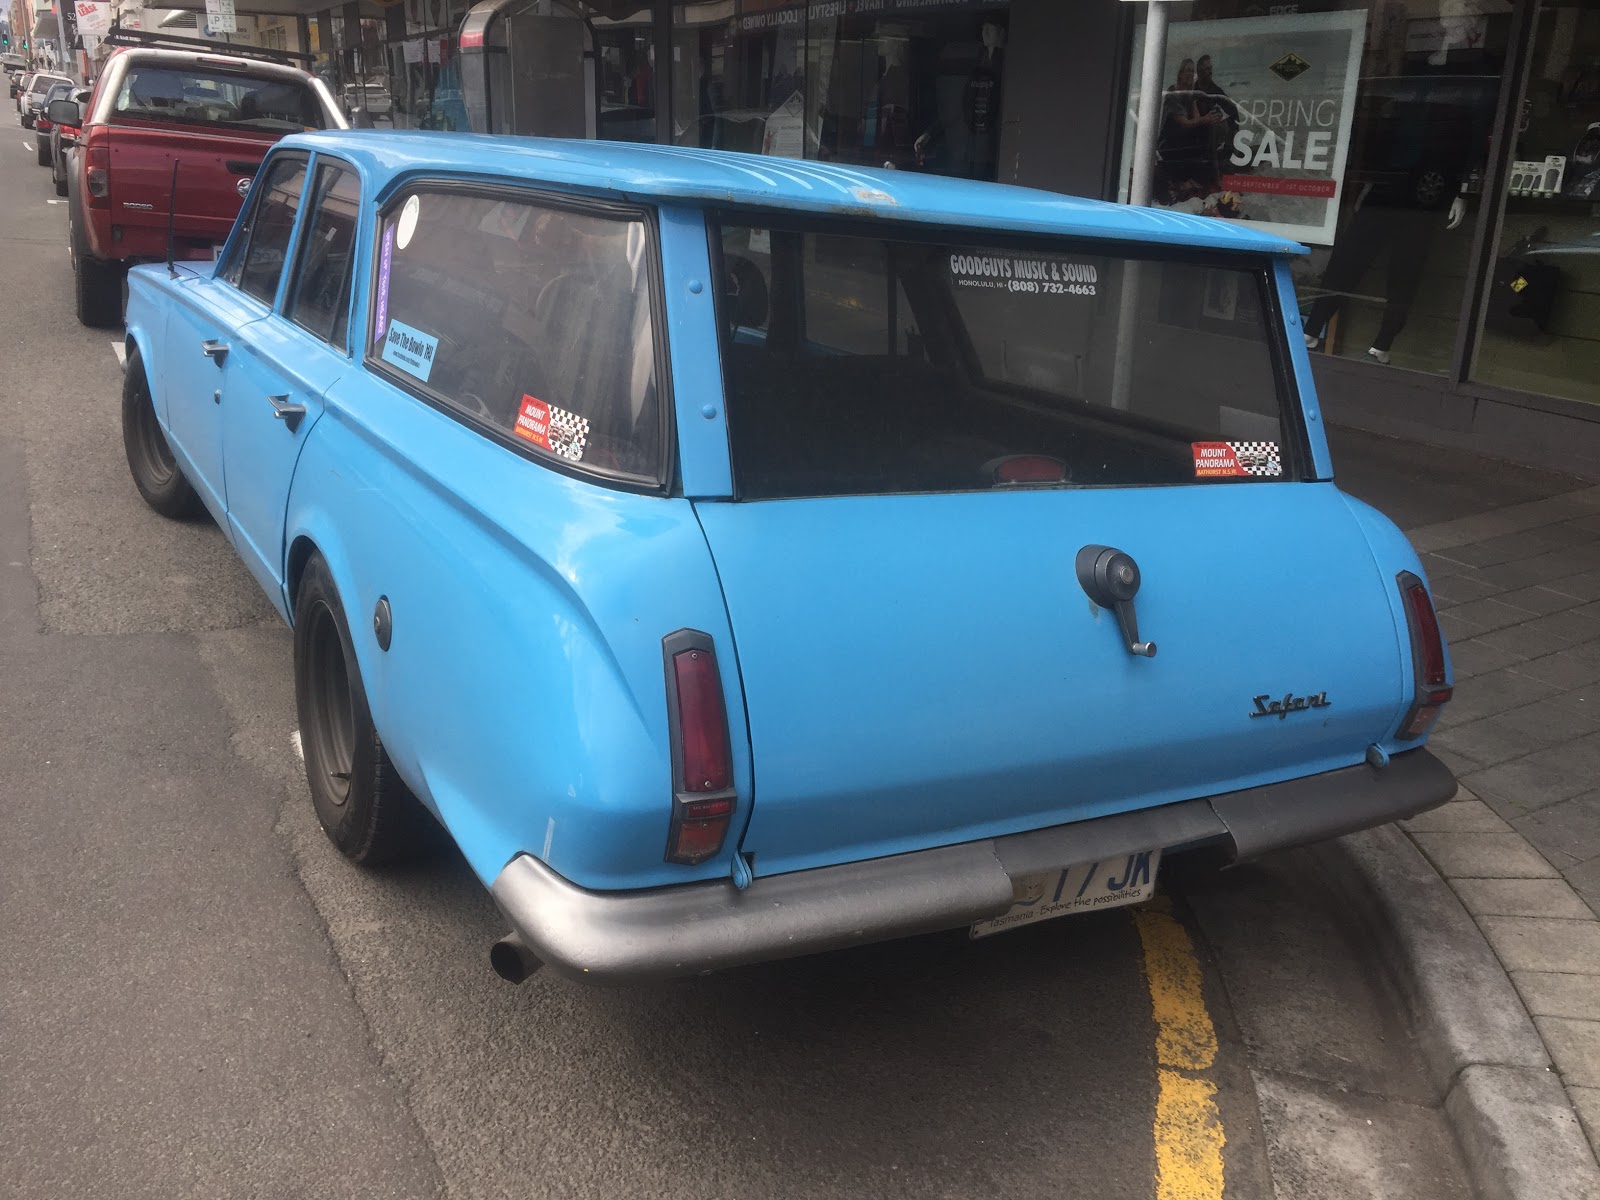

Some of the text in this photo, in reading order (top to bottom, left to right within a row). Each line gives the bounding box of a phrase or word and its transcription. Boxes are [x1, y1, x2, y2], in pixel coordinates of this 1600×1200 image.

[1234, 99, 1336, 127] SPRING
[1229, 129, 1332, 170] SALE
[950, 254, 1098, 283] GOODGUYS MUSIC & SOUND
[1007, 279, 1039, 294] (808)
[1042, 282, 1096, 296] 732-4663
[517, 414, 547, 436] PANORAMA
[524, 404, 546, 421] MOUNT
[1195, 458, 1235, 468] PANORAMA
[1200, 448, 1227, 458] MOUNT
[1249, 691, 1331, 720] Safari
[989, 910, 1033, 928] Tasmania
[1040, 901, 1072, 916] Explore
[1074, 897, 1091, 907] the
[1093, 888, 1141, 906] possibilities
